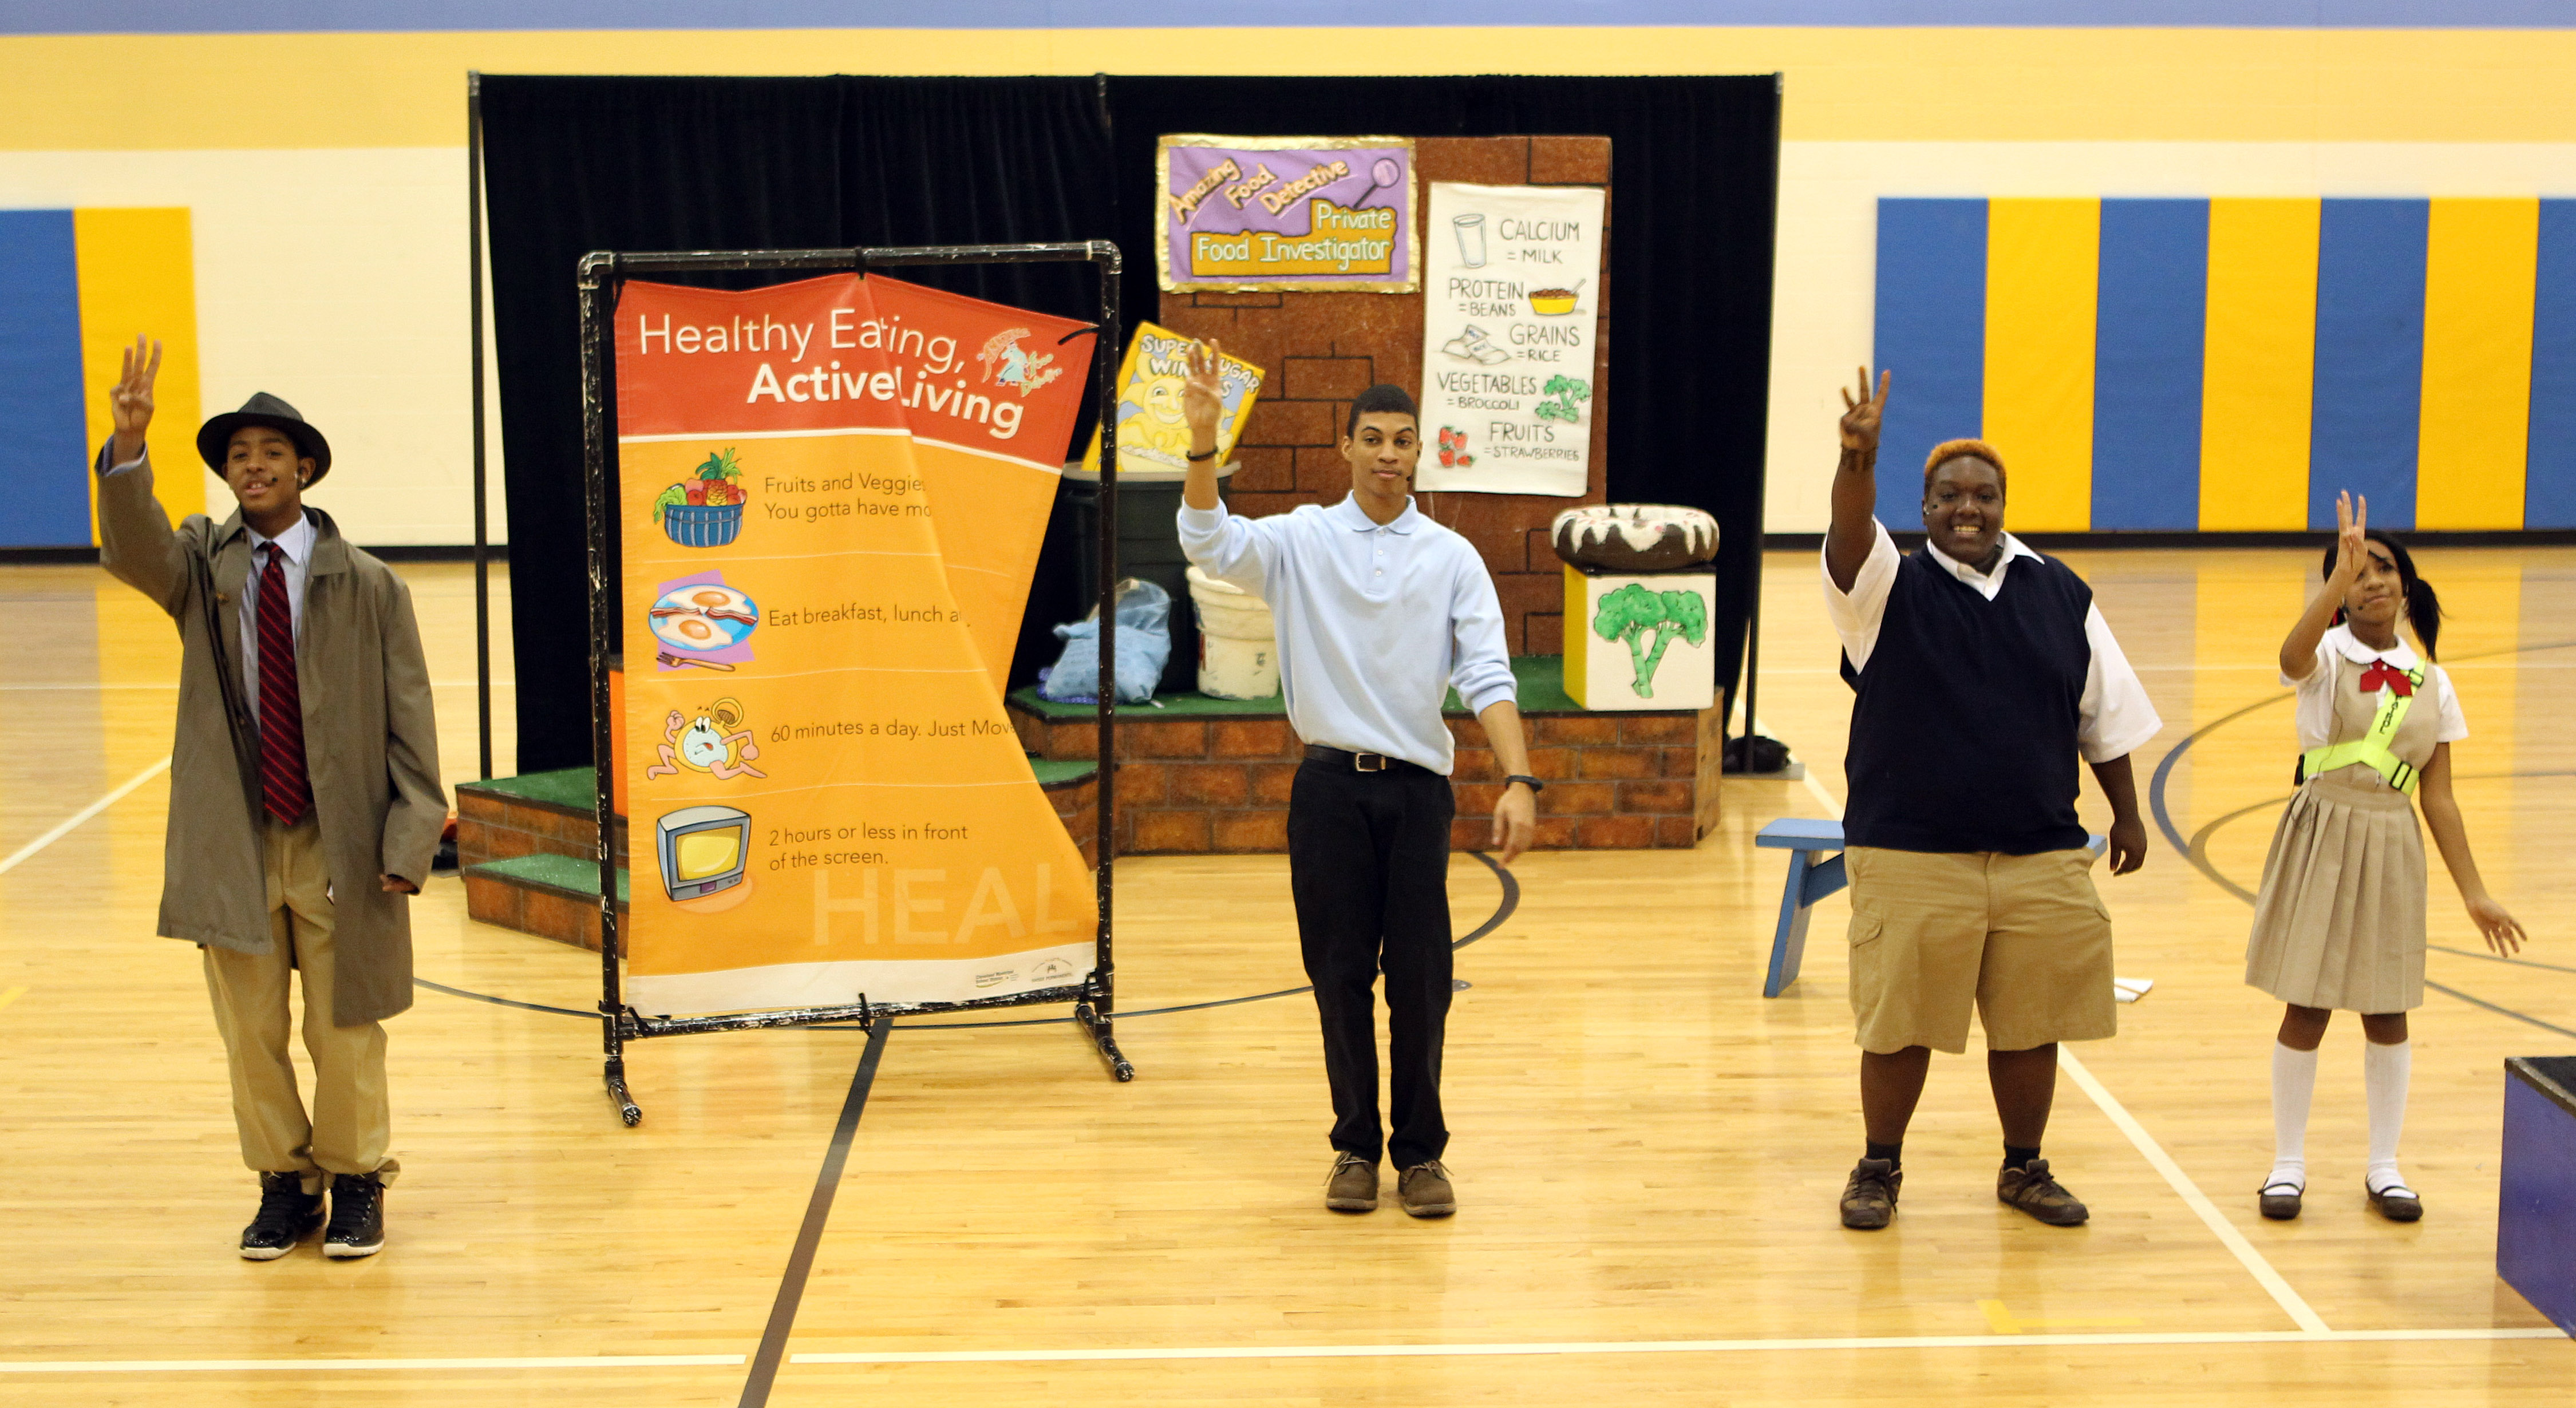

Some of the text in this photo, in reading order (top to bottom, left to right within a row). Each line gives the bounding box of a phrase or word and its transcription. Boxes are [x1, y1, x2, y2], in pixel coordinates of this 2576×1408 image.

[1170, 157, 1350, 224] Amazing Food Detective
[1317, 202, 1392, 229] Private
[1500, 219, 1579, 241] CALCIUM
[1198, 236, 1391, 271] Food Investigator
[1523, 249, 1563, 264] MILK
[1449, 278, 1524, 300] PROTEIN
[639, 314, 814, 362] Healthy
[1141, 334, 1193, 357] SUPE
[1510, 323, 1580, 347] GRAINS
[1437, 372, 1537, 395] VEGETABLES
[746, 361, 895, 404] Active
[895, 365, 1024, 440] Living
[1490, 421, 1555, 442] FRUITS
[765, 476, 815, 493] Fruits
[821, 472, 853, 491] and
[765, 503, 799, 519] You
[805, 503, 851, 523] gotta
[858, 498, 899, 516] have
[769, 610, 798, 626] Eat
[804, 603, 887, 624] breakfast,
[894, 604, 943, 622] lunch
[771, 725, 790, 742] 60
[796, 722, 863, 739] minutes
[870, 725, 880, 735] a
[886, 719, 921, 741] day.
[928, 721, 966, 737] Just
[769, 822, 969, 846] 2 hours or less in front
[769, 851, 888, 871] of the screen.
[814, 863, 1078, 946] HEAL
